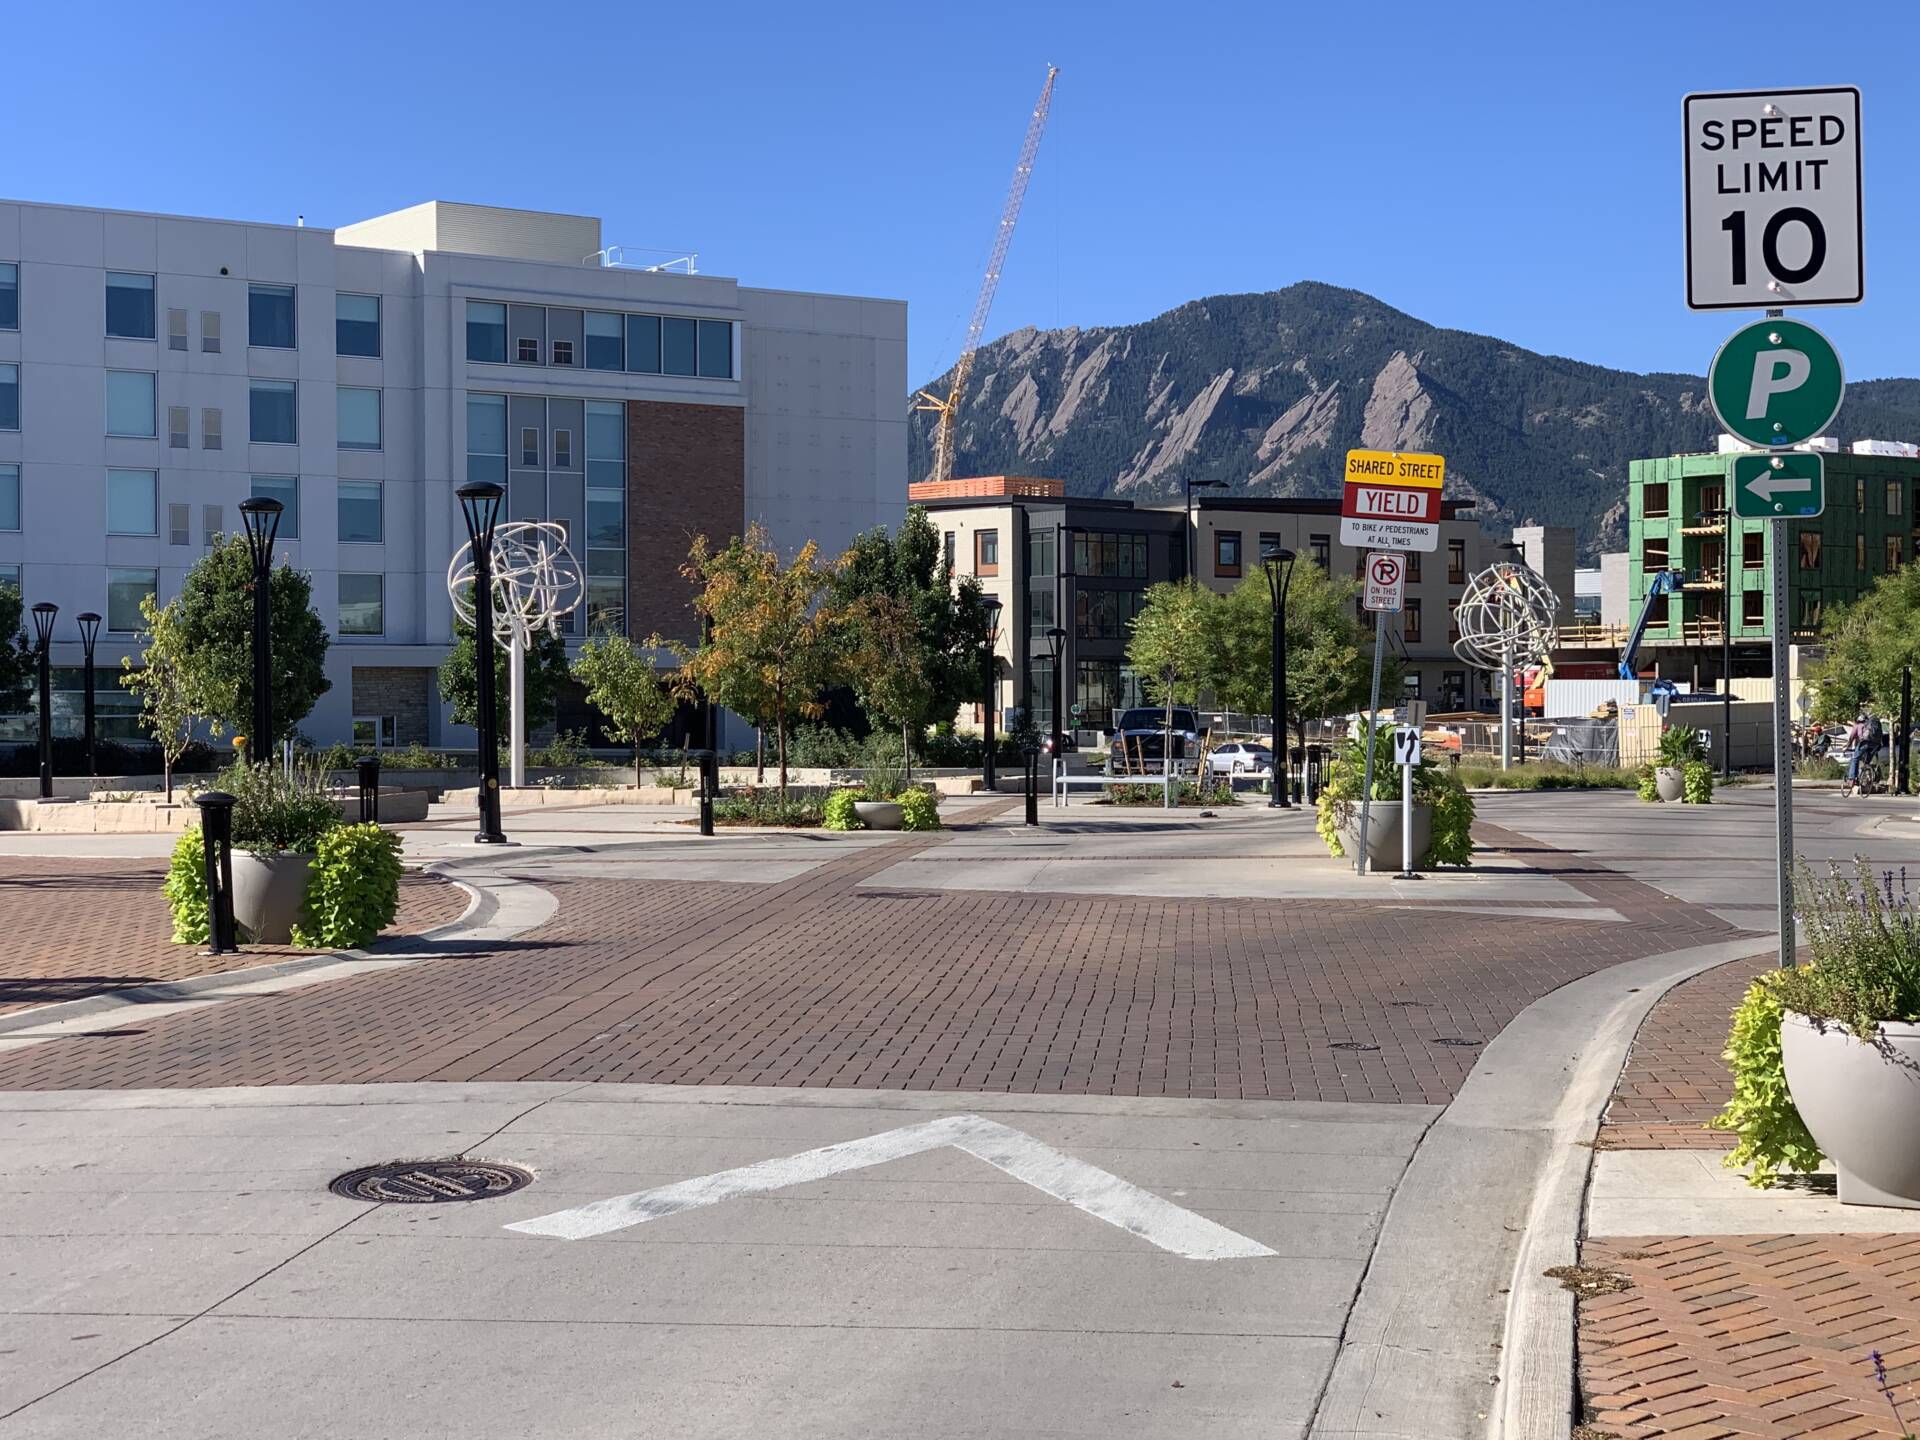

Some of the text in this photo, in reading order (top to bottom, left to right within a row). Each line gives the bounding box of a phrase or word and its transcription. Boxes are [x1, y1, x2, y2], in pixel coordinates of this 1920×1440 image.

[1700, 114, 1845, 151] SPEED
[1717, 159, 1829, 194] LIMIT
[1721, 206, 1827, 286] 10
[1745, 348, 1811, 420] P
[1349, 459, 1441, 479] SHARED STREET
[1366, 491, 1419, 514] YIELD
[1352, 522, 1360, 531] TO
[1362, 523, 1377, 532] BIKE
[1385, 525, 1429, 535] PEDESTRIANS
[1367, 535, 1411, 546] AT ALL TIMES
[1370, 586, 1397, 595] ON THIS
[1371, 596, 1395, 605] STREET
